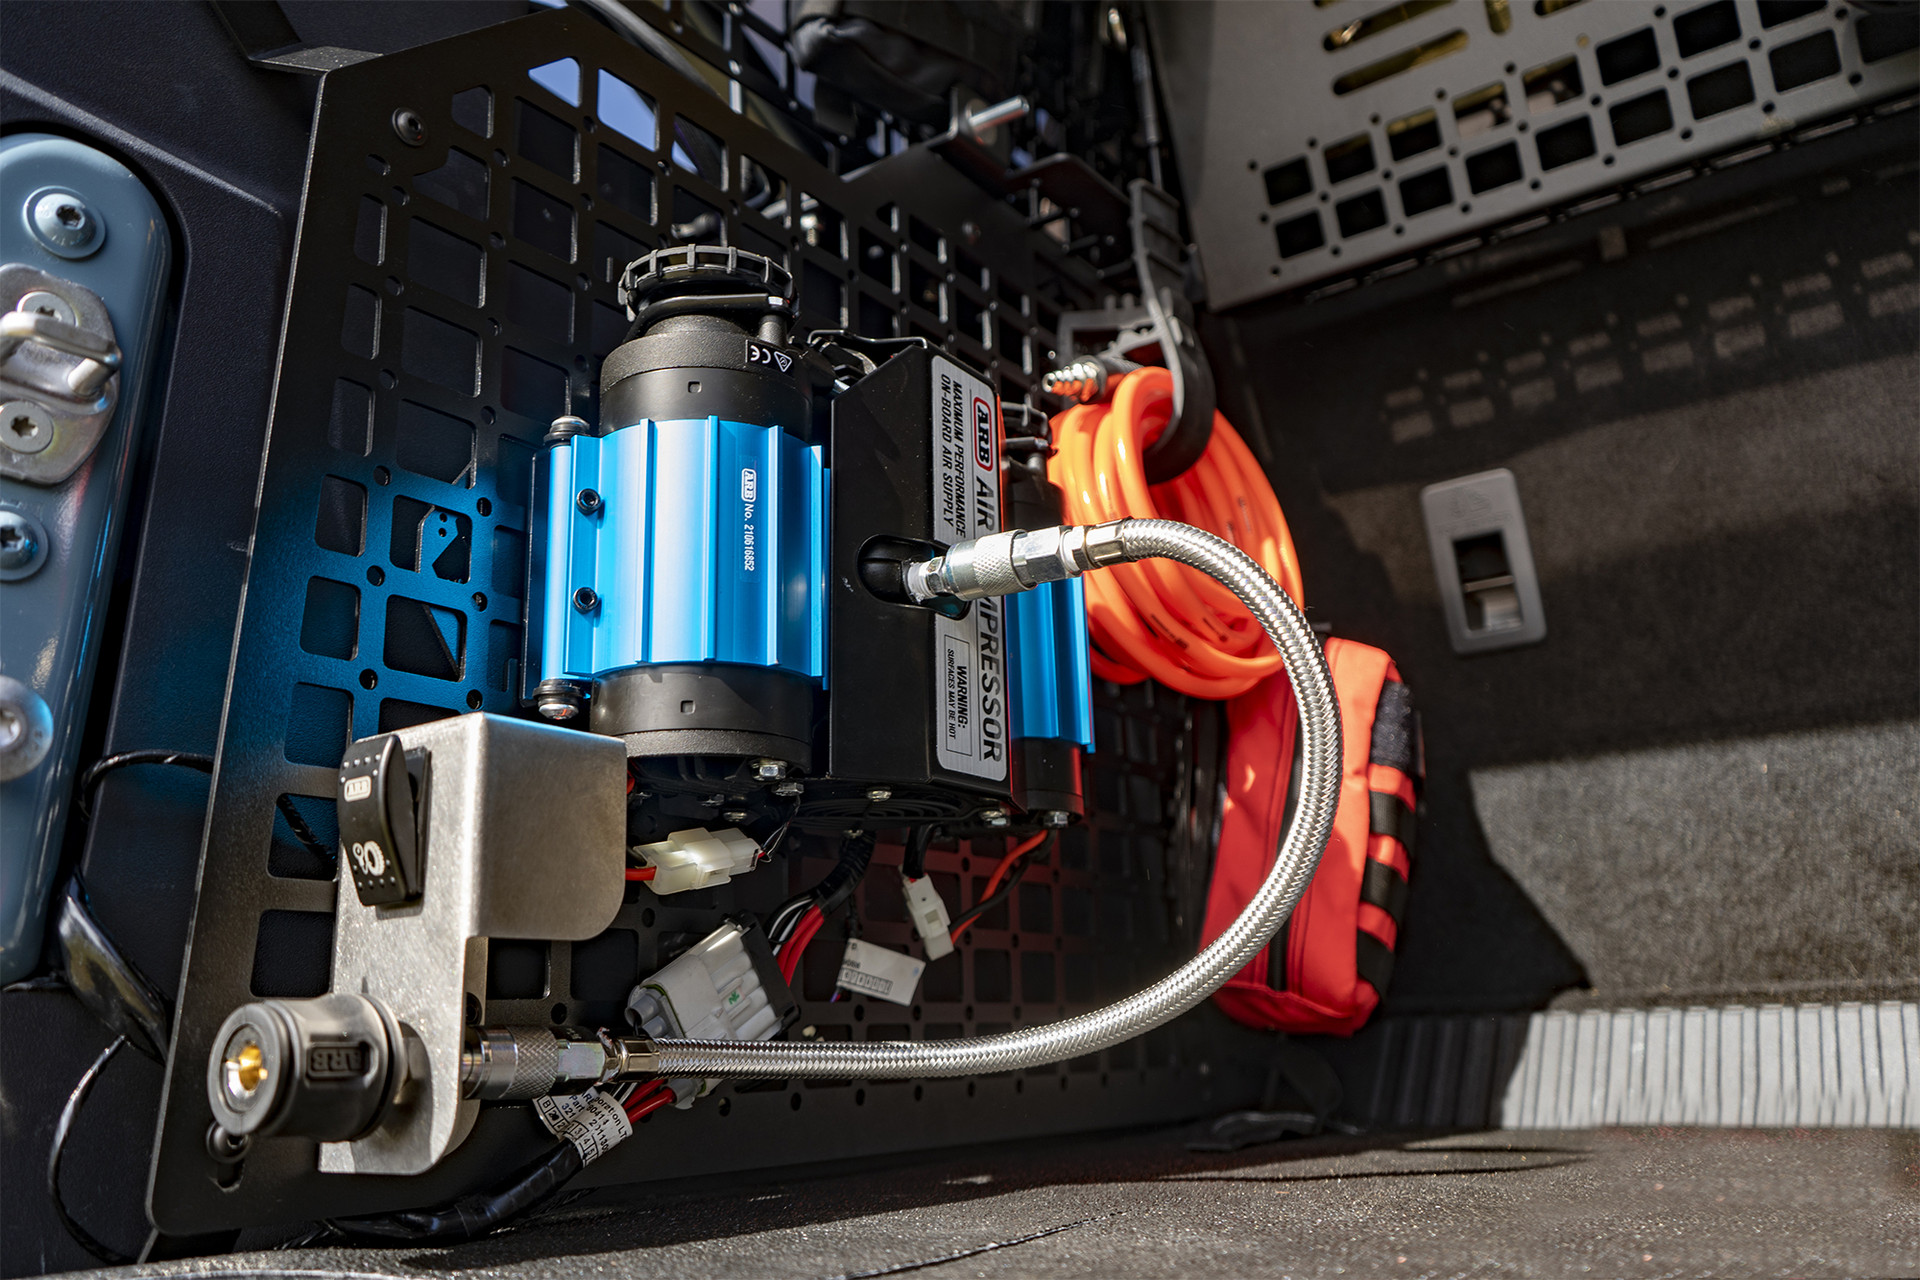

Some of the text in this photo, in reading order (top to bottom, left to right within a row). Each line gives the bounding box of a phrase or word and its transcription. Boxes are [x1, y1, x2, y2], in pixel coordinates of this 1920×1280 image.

[941, 373, 954, 526] ON-BOARD AIR SUPPLY
[952, 380, 966, 538] MAXIMUM PERFORMANCE
[743, 469, 755, 571] ARB No. 210616852
[976, 402, 1003, 762] ARB AIR MPRESSOR
[947, 648, 955, 689] SURFACES
[948, 690, 956, 708] MAY
[948, 710, 956, 721] BE
[956, 665, 968, 729] WARNING:
[346, 778, 369, 798] ARB
[310, 1046, 363, 1073] ARB
